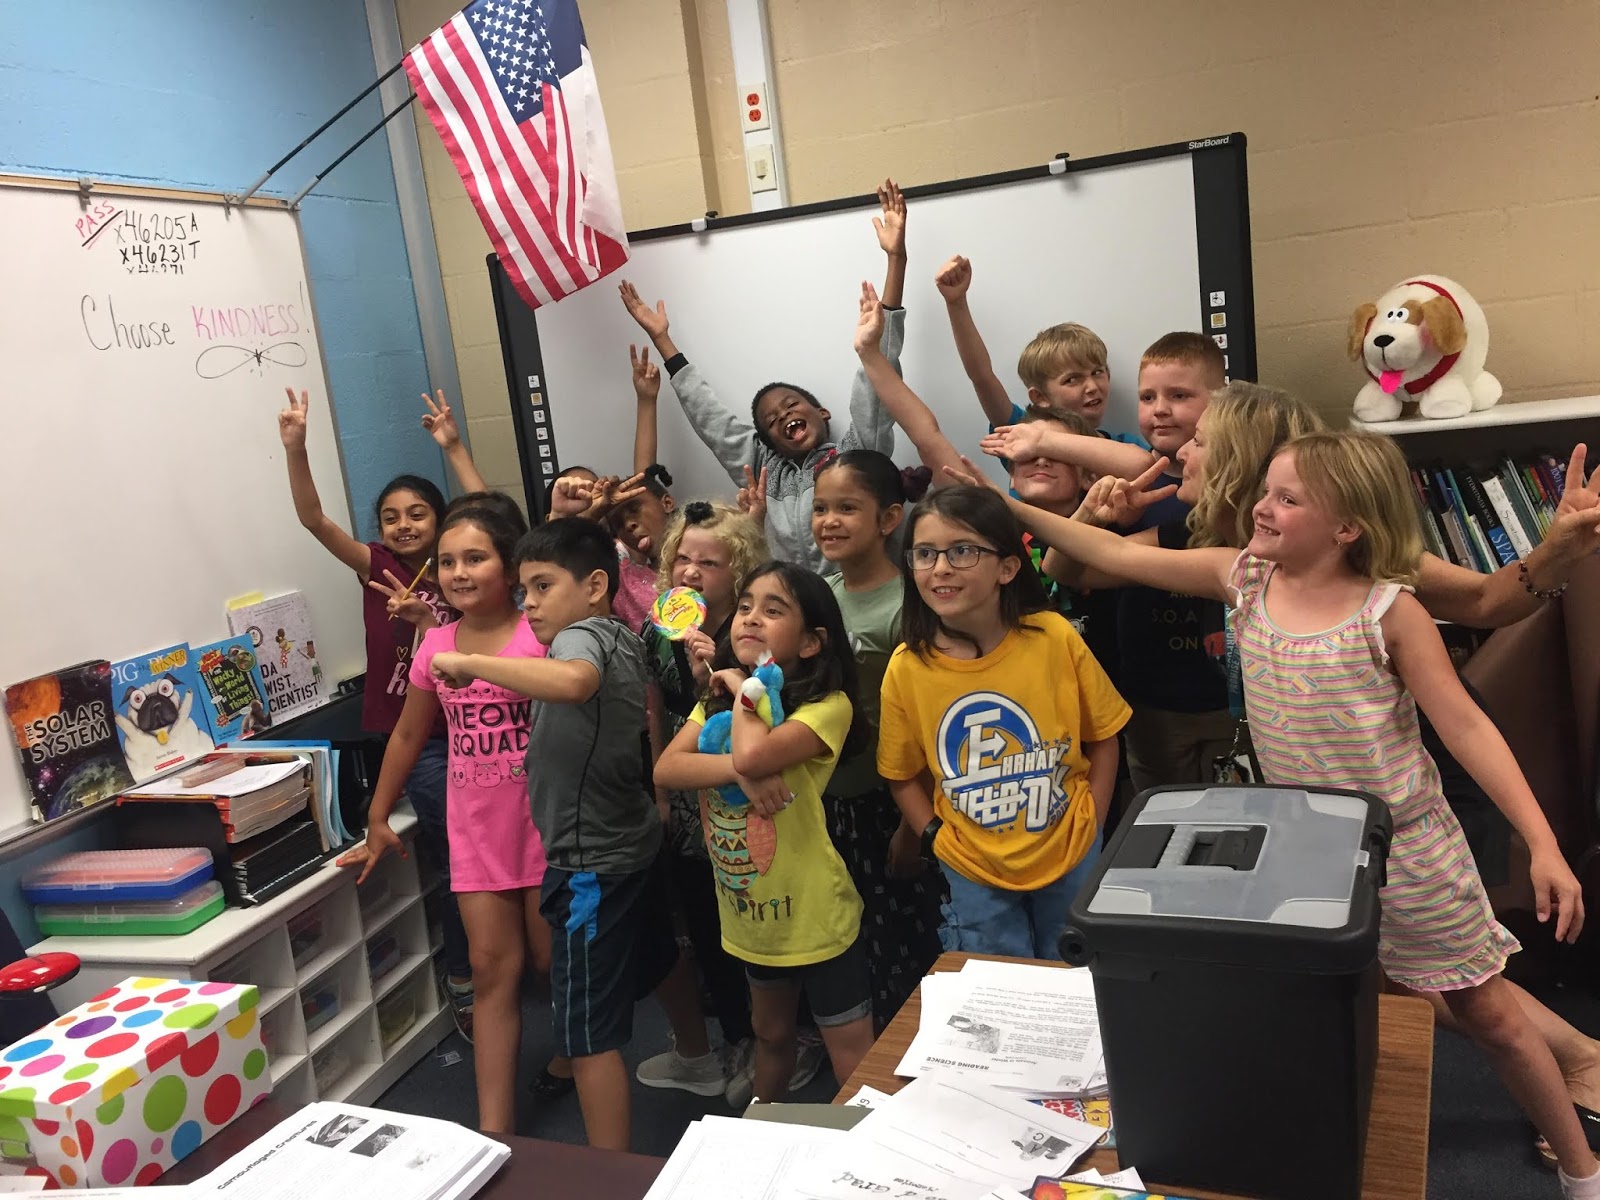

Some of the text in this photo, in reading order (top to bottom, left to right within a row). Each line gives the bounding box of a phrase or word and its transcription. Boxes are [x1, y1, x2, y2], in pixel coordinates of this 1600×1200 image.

[1188, 136, 1230, 149] StarBoard
[75, 200, 115, 238] PASS
[81, 294, 175, 350] Choose
[1169, 636, 1198, 650] ON
[152, 649, 187, 674] WINNER
[260, 661, 278, 680] DA
[212, 669, 235, 686] Wacky
[224, 672, 245, 690] World
[226, 683, 250, 700] Living
[268, 682, 319, 713] CIENTIST
[32, 700, 105, 741] SOLAR
[446, 700, 533, 730] MEOW
[25, 723, 35, 743] THE
[30, 720, 110, 763] SYSTEM
[452, 728, 531, 758] SQUAD
[926, 1056, 990, 1071] READING SCIENCE
[217, 1149, 277, 1190] Camouflaged
[275, 1120, 318, 1149] Creatures
